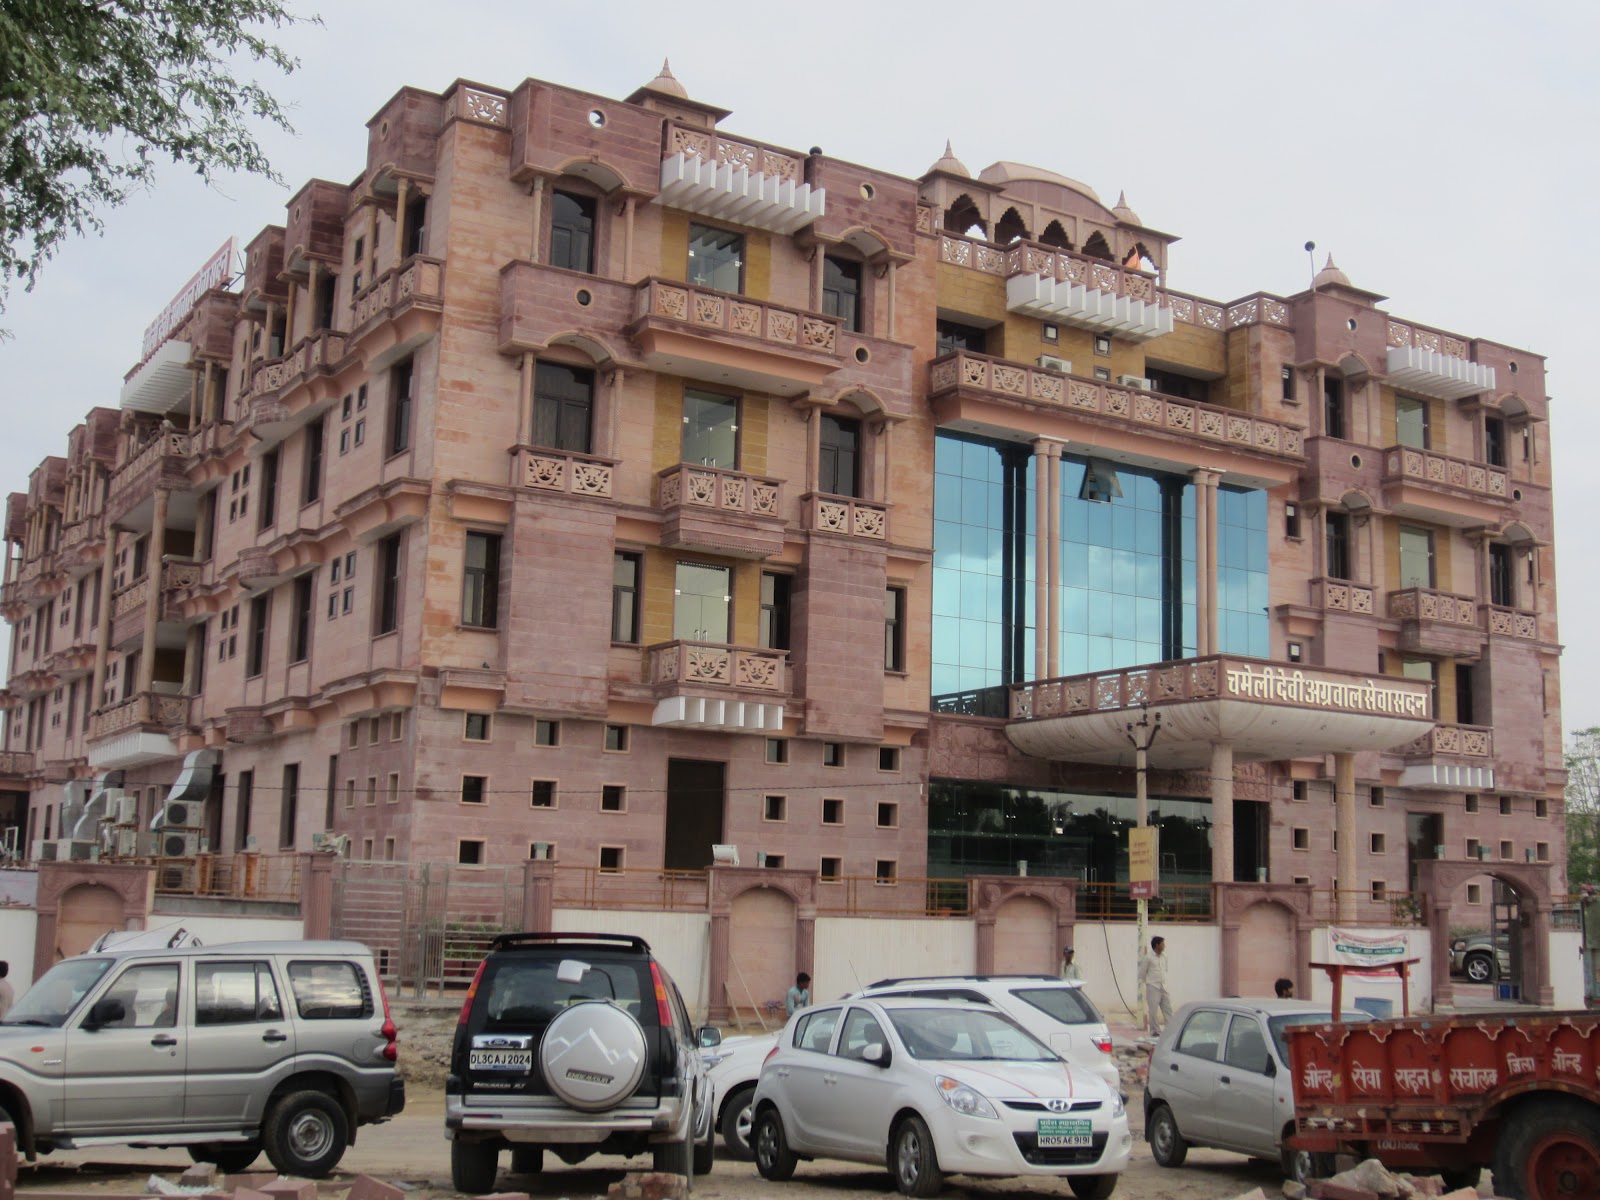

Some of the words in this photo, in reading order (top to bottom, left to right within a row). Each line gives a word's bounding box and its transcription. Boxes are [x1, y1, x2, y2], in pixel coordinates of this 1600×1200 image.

[1226, 664, 1275, 699] चमेली
[1275, 668, 1305, 701] देवी
[1305, 679, 1363, 709] अग्रवाल
[1351, 1060, 1382, 1093] सेवा
[1394, 1068, 1430, 1094] सदन
[1506, 1052, 1536, 1076] जिला
[1040, 1136, 1062, 1145] HR05
[1063, 1136, 1073, 1145] AE
[1074, 1136, 1090, 1145] 9191
